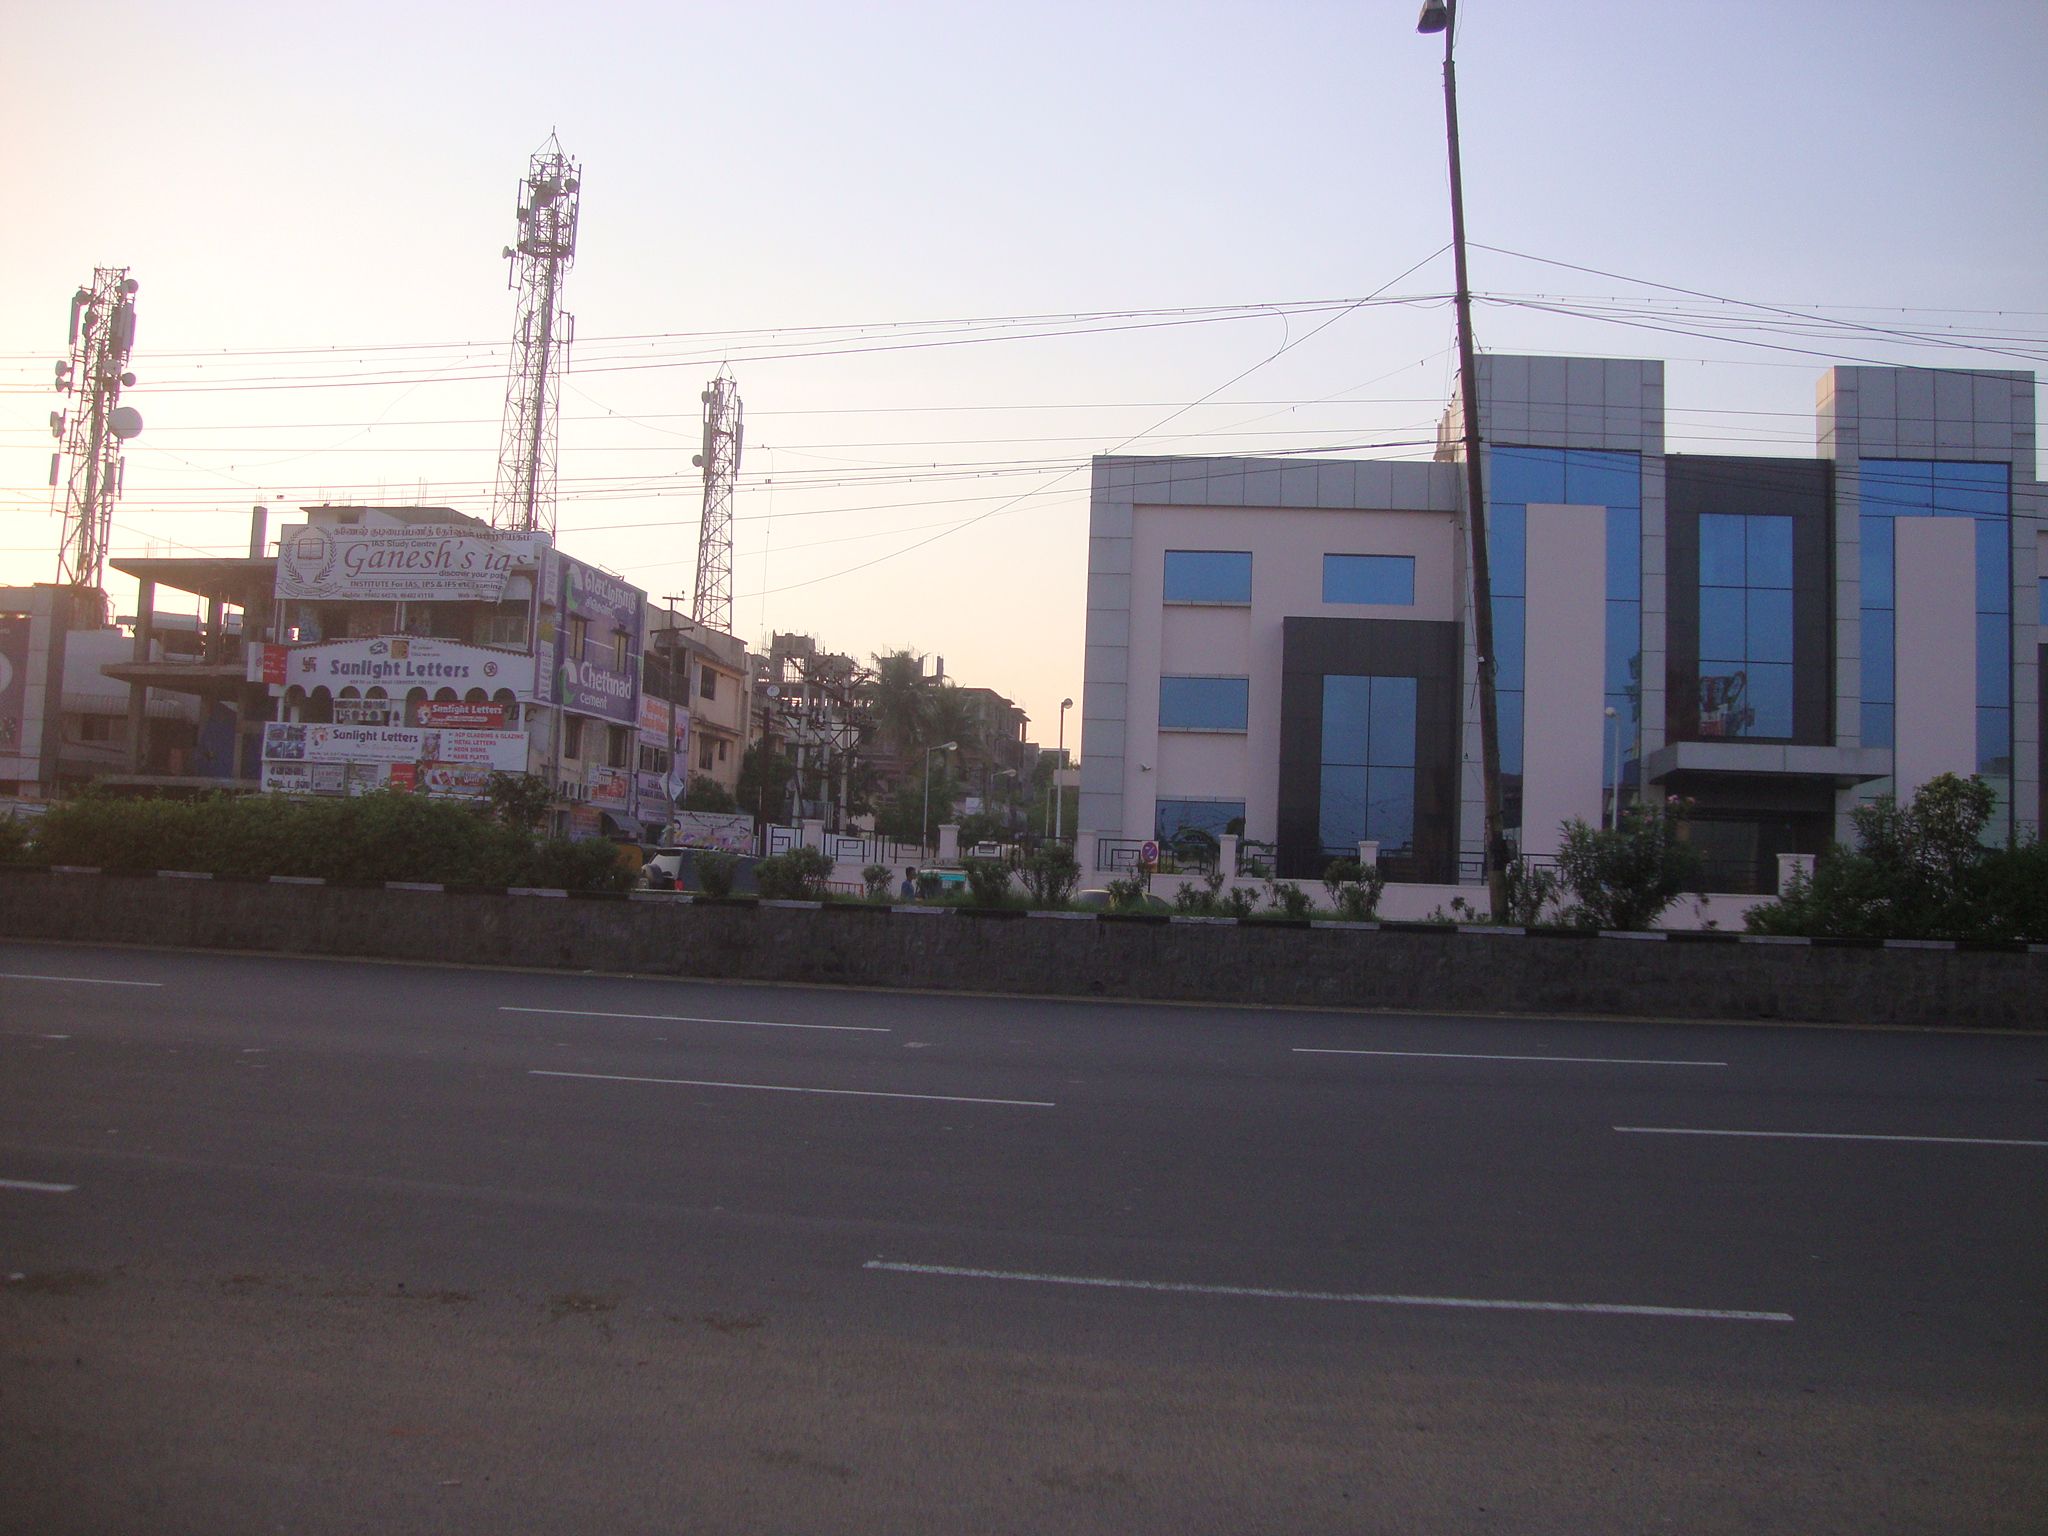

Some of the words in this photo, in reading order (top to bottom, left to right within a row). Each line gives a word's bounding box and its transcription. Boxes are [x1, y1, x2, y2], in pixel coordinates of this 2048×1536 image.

[387, 540, 409, 548] Study
[344, 540, 476, 578] Ganesh's
[471, 570, 489, 578] your
[405, 581, 420, 589] IAS,
[330, 660, 400, 679] Sunlight
[406, 661, 469, 678] Letters
[580, 661, 633, 700] Chettinad
[580, 692, 608, 710] cement
[432, 704, 470, 715] Sunlight
[471, 705, 503, 715] Letters
[333, 729, 377, 742] Sunlight
[381, 731, 418, 743] Letters
